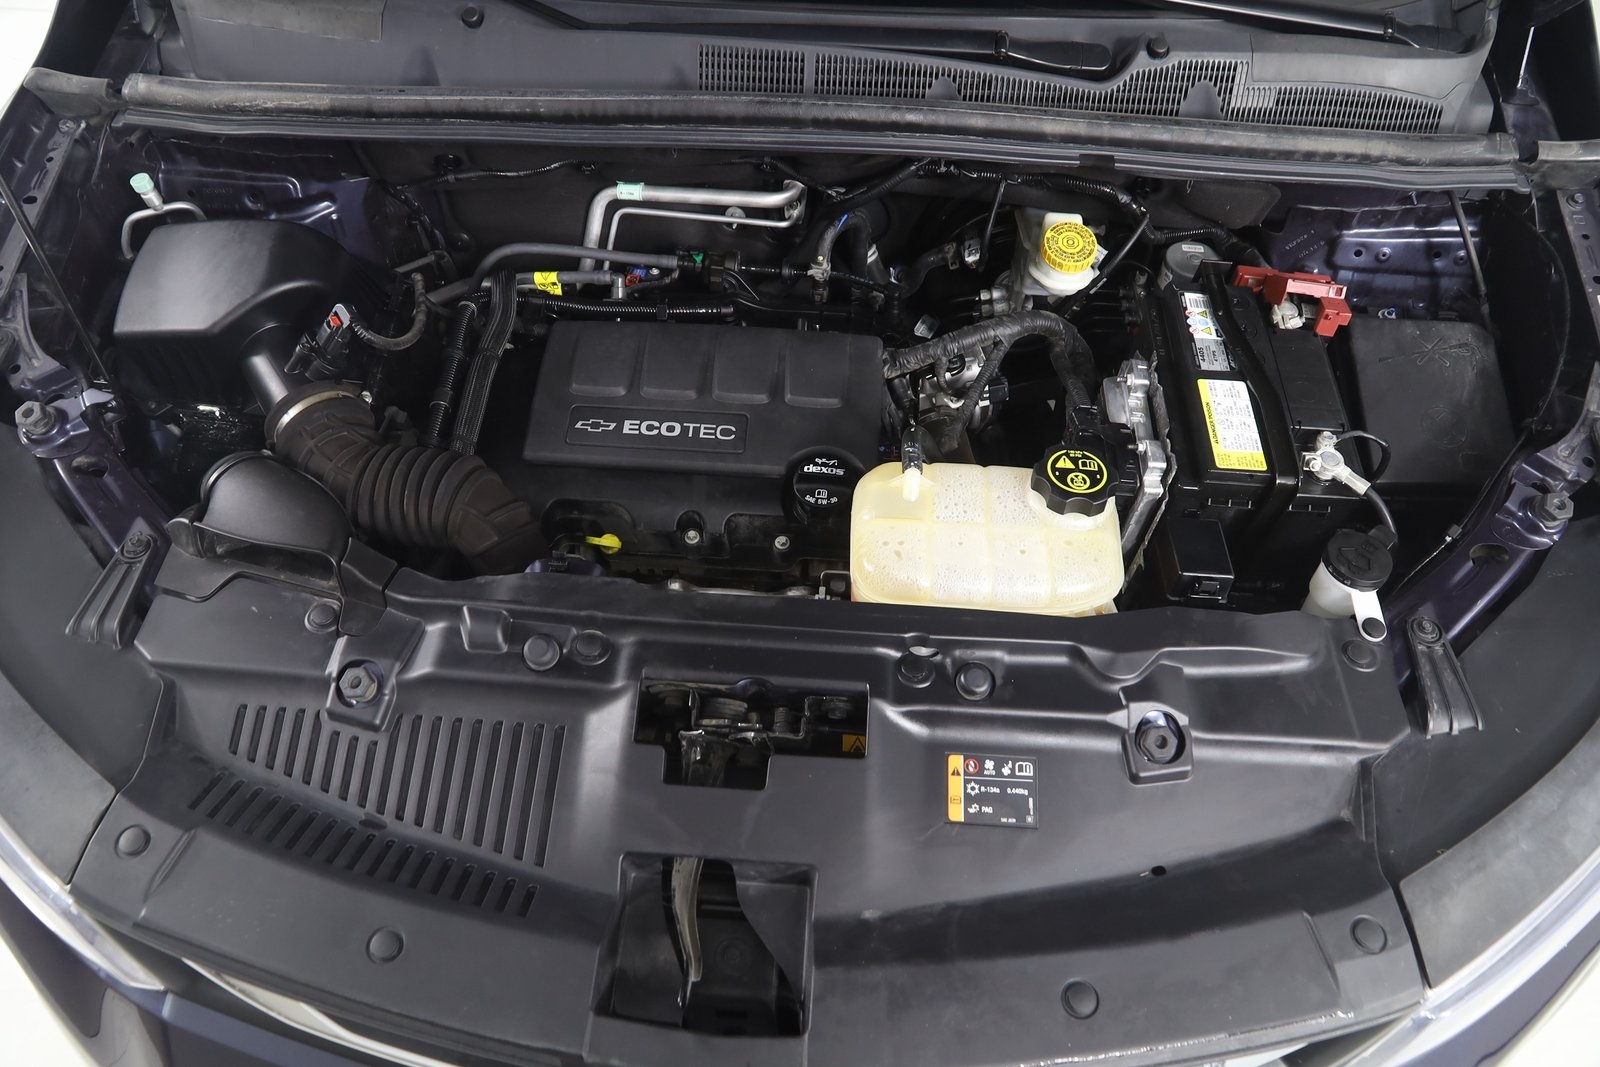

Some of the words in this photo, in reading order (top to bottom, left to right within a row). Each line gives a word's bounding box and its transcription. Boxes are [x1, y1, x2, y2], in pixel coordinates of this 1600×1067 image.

[1205, 402, 1213, 420] POISON
[622, 419, 737, 441] ECOTEC
[803, 463, 846, 476] dexos
[804, 494, 817, 504] SAE
[817, 496, 838, 505] 5W-30
[980, 785, 1001, 794] R-134a
[981, 805, 993, 814] PAG
